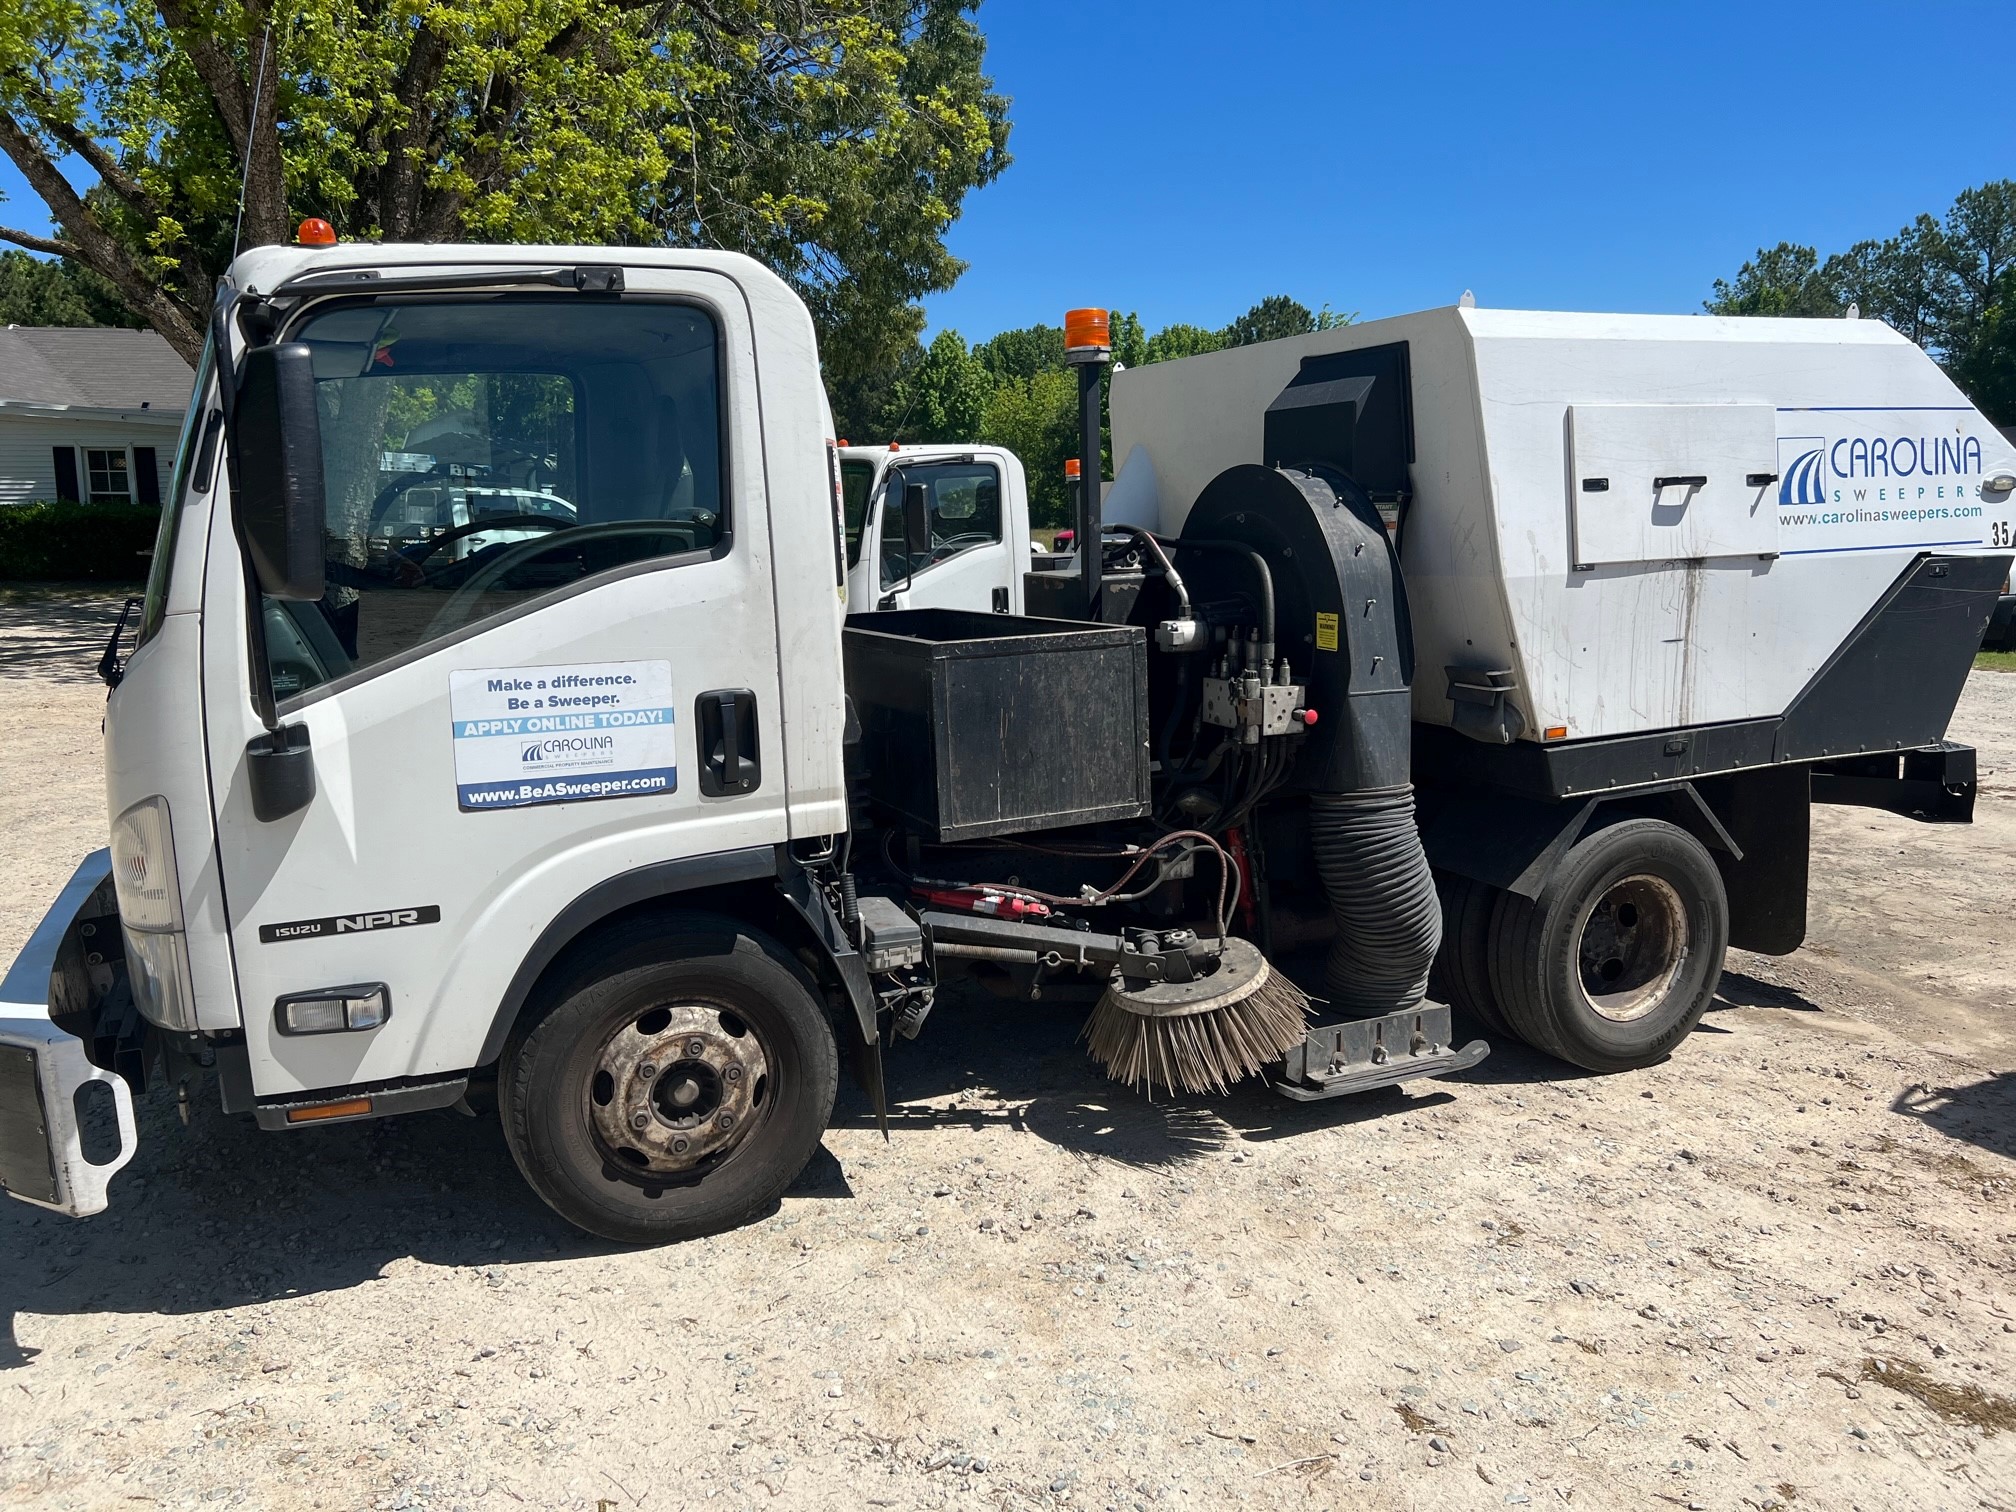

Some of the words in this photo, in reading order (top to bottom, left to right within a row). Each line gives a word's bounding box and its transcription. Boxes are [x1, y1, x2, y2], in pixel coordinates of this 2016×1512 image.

[1830, 436, 1982, 479] CAROLINA
[1833, 485, 1982, 503] SWEEPERS
[1779, 505, 1982, 526] www.carolinasweepers.com
[1992, 521, 2009, 546] 35
[487, 678, 533, 692] Make
[537, 680, 547, 690] a
[551, 674, 637, 688] difference.
[507, 697, 529, 710] Be
[534, 699, 544, 709] a
[548, 693, 620, 708] Sweeper.
[463, 719, 523, 737] APPLY
[527, 714, 595, 732] ONLINE
[599, 710, 663, 727] TODAY!
[543, 736, 613, 752] CAROLINA
[468, 776, 666, 803] www.BeASweeper.com
[275, 923, 321, 937] ISUZU
[336, 910, 418, 932] NPR
